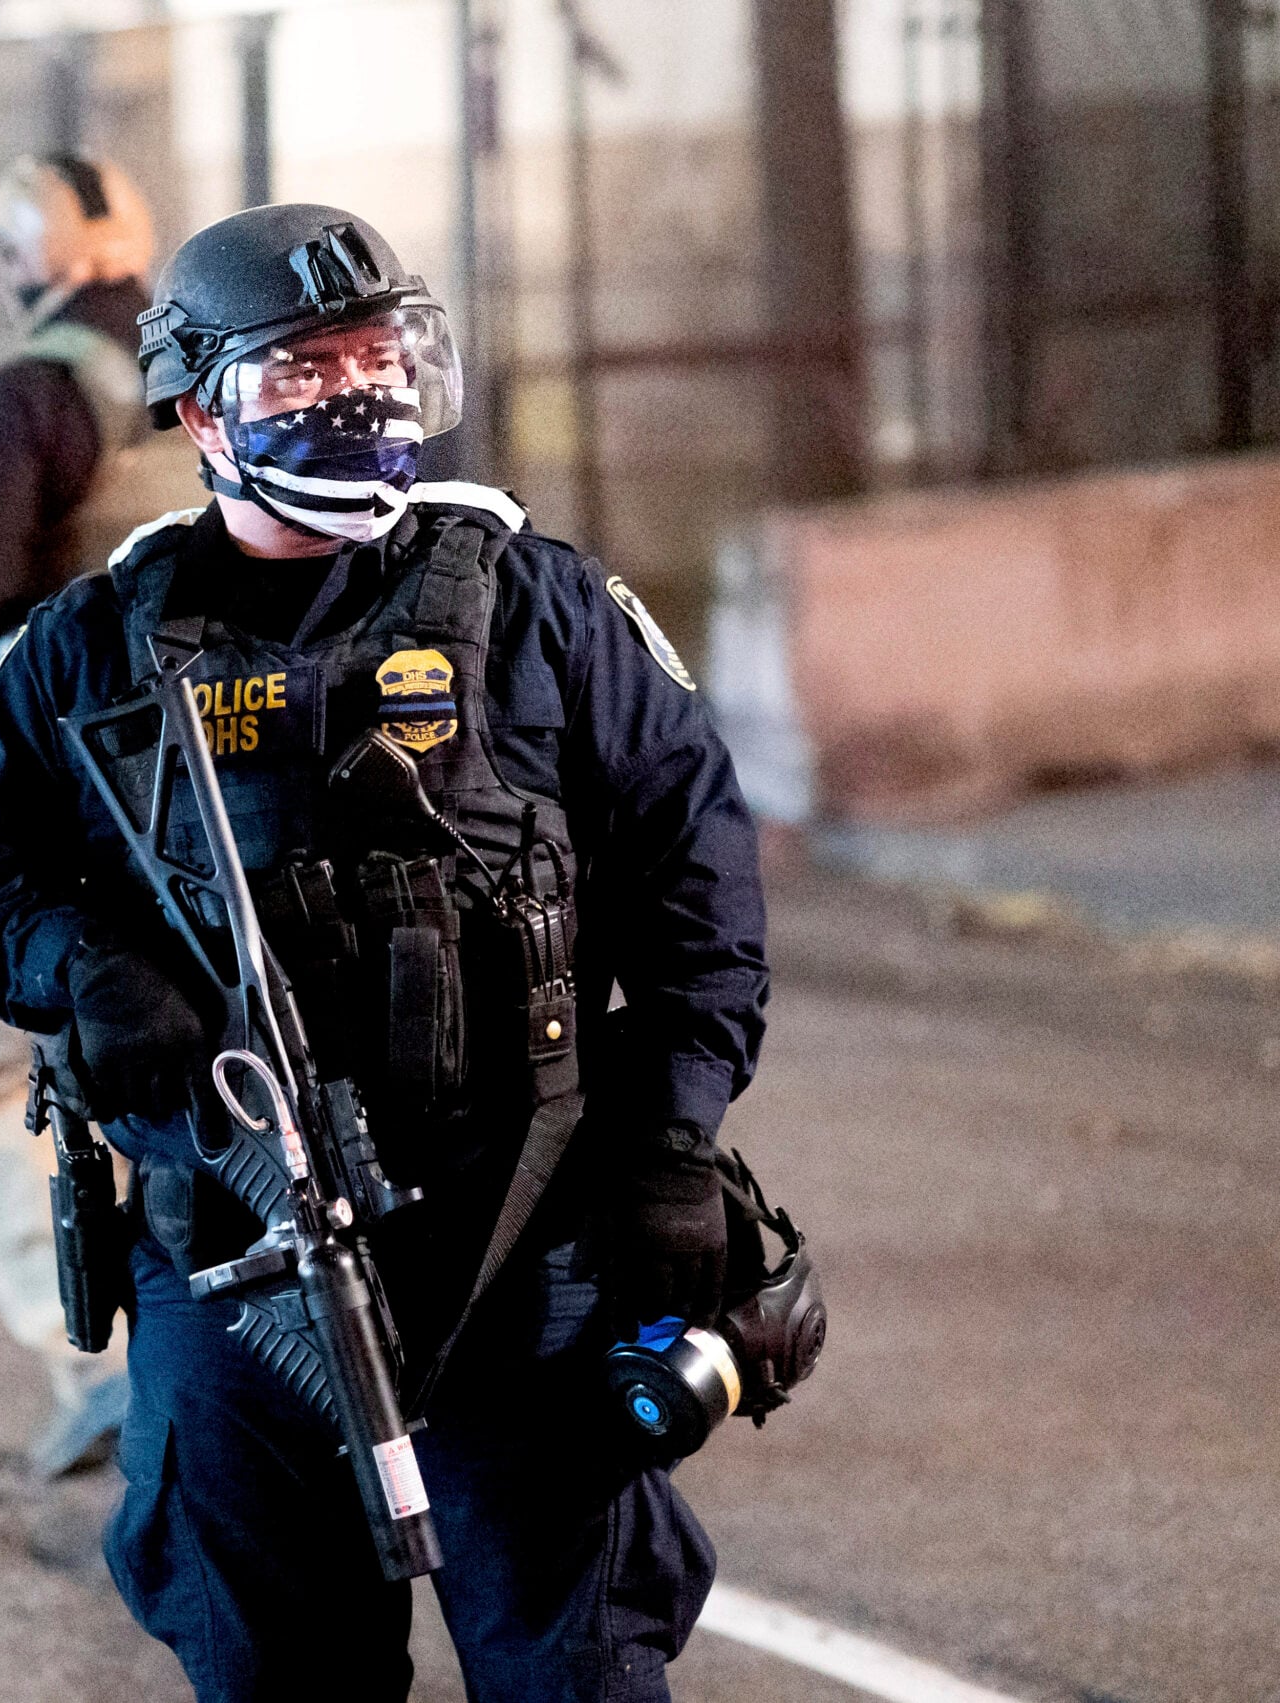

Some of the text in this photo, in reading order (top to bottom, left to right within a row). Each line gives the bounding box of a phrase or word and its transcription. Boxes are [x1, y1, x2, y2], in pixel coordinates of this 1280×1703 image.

[404, 671, 427, 681] DHS
[193, 673, 286, 718] OLICE
[404, 731, 436, 741] POLICE
